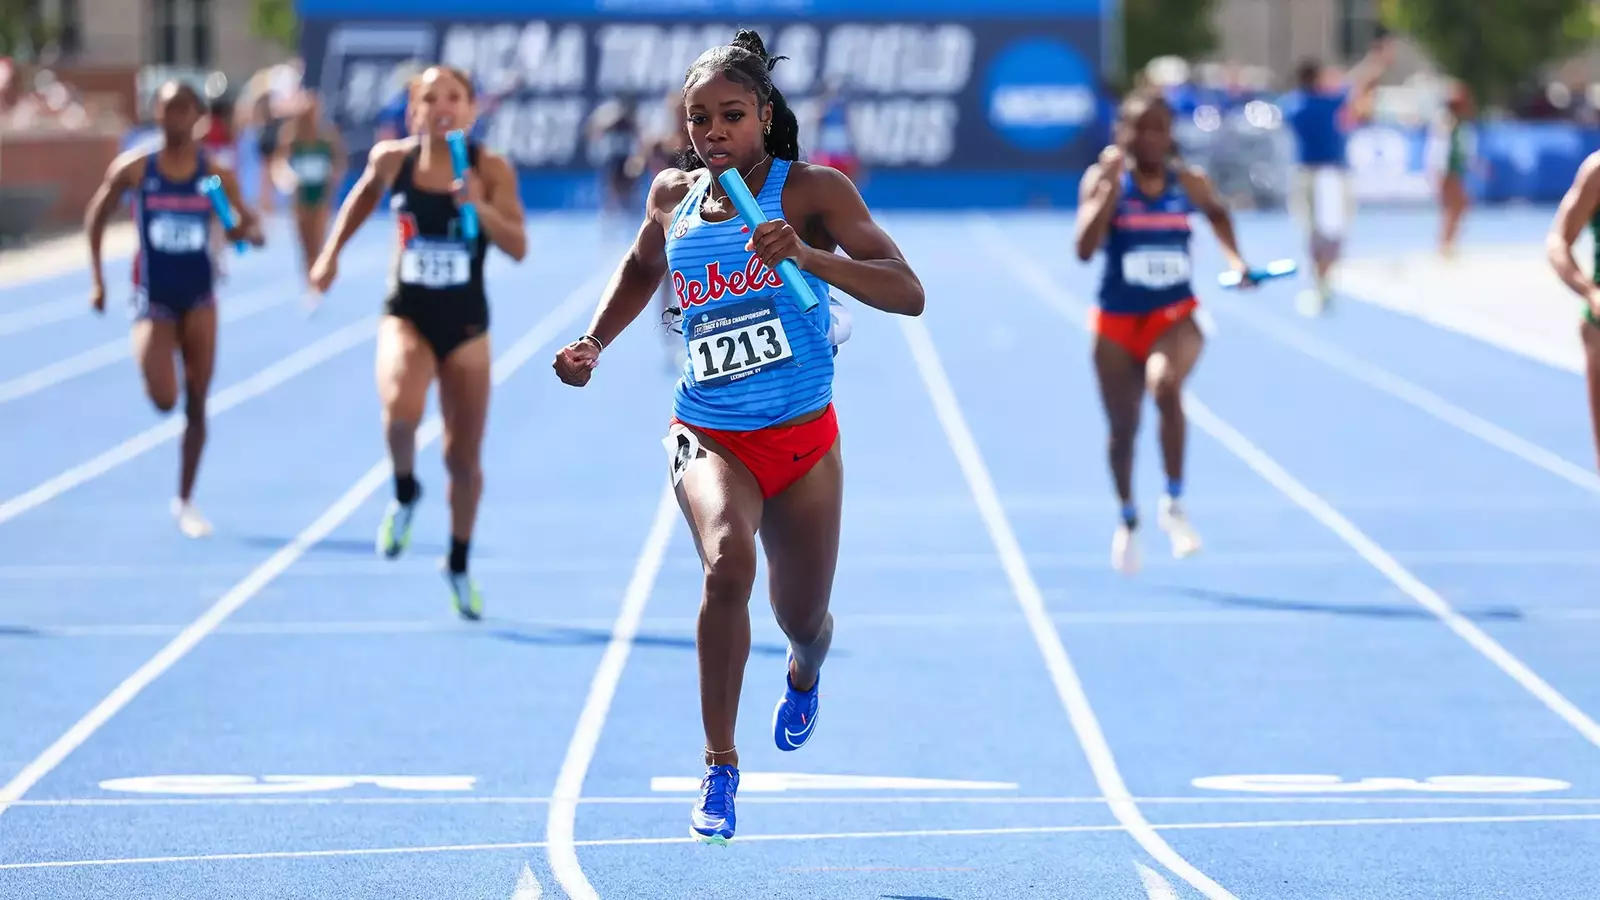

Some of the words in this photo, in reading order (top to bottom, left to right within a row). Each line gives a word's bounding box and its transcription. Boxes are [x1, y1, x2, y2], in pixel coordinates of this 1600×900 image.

[672, 253, 783, 309] Rebels
[732, 309, 770, 323] CHAMPIONSHIPS
[698, 325, 782, 377] 1213
